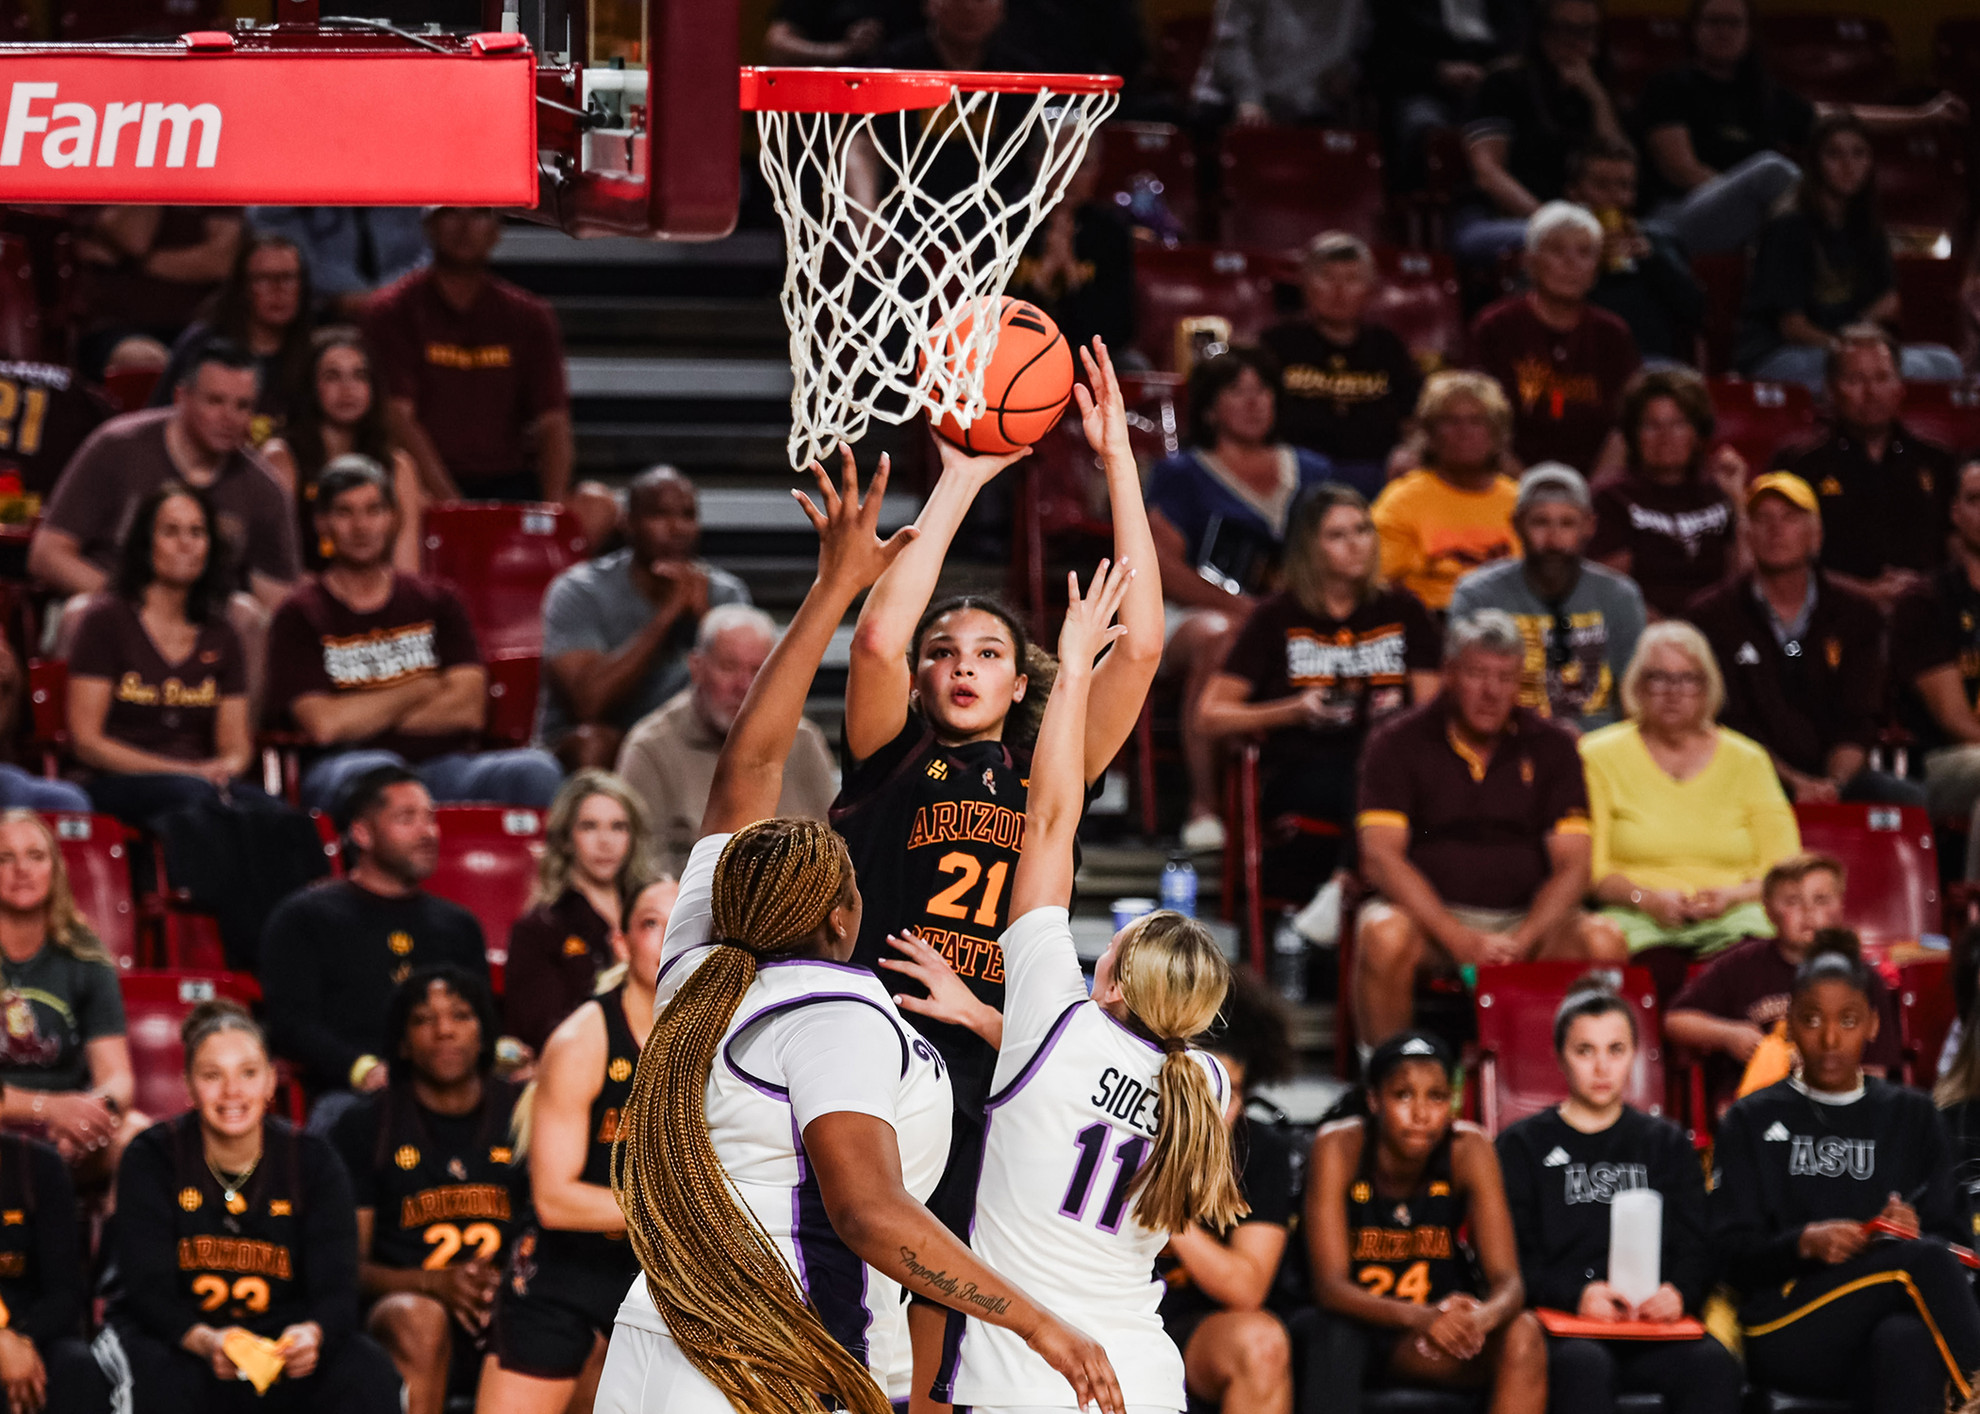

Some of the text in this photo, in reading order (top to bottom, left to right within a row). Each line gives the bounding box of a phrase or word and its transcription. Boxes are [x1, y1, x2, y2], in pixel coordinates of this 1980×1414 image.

[0, 82, 223, 169] Farm
[926, 851, 1009, 928] 21
[913, 919, 1006, 984] TATE
[1058, 1120, 1150, 1236] 11
[1788, 1135, 1876, 1181] ASU
[178, 1234, 293, 1281] ARIZONA
[422, 1222, 502, 1271] 22
[899, 1246, 1013, 1316] Imperfectly Beautiful
[1358, 1261, 1433, 1307] 24
